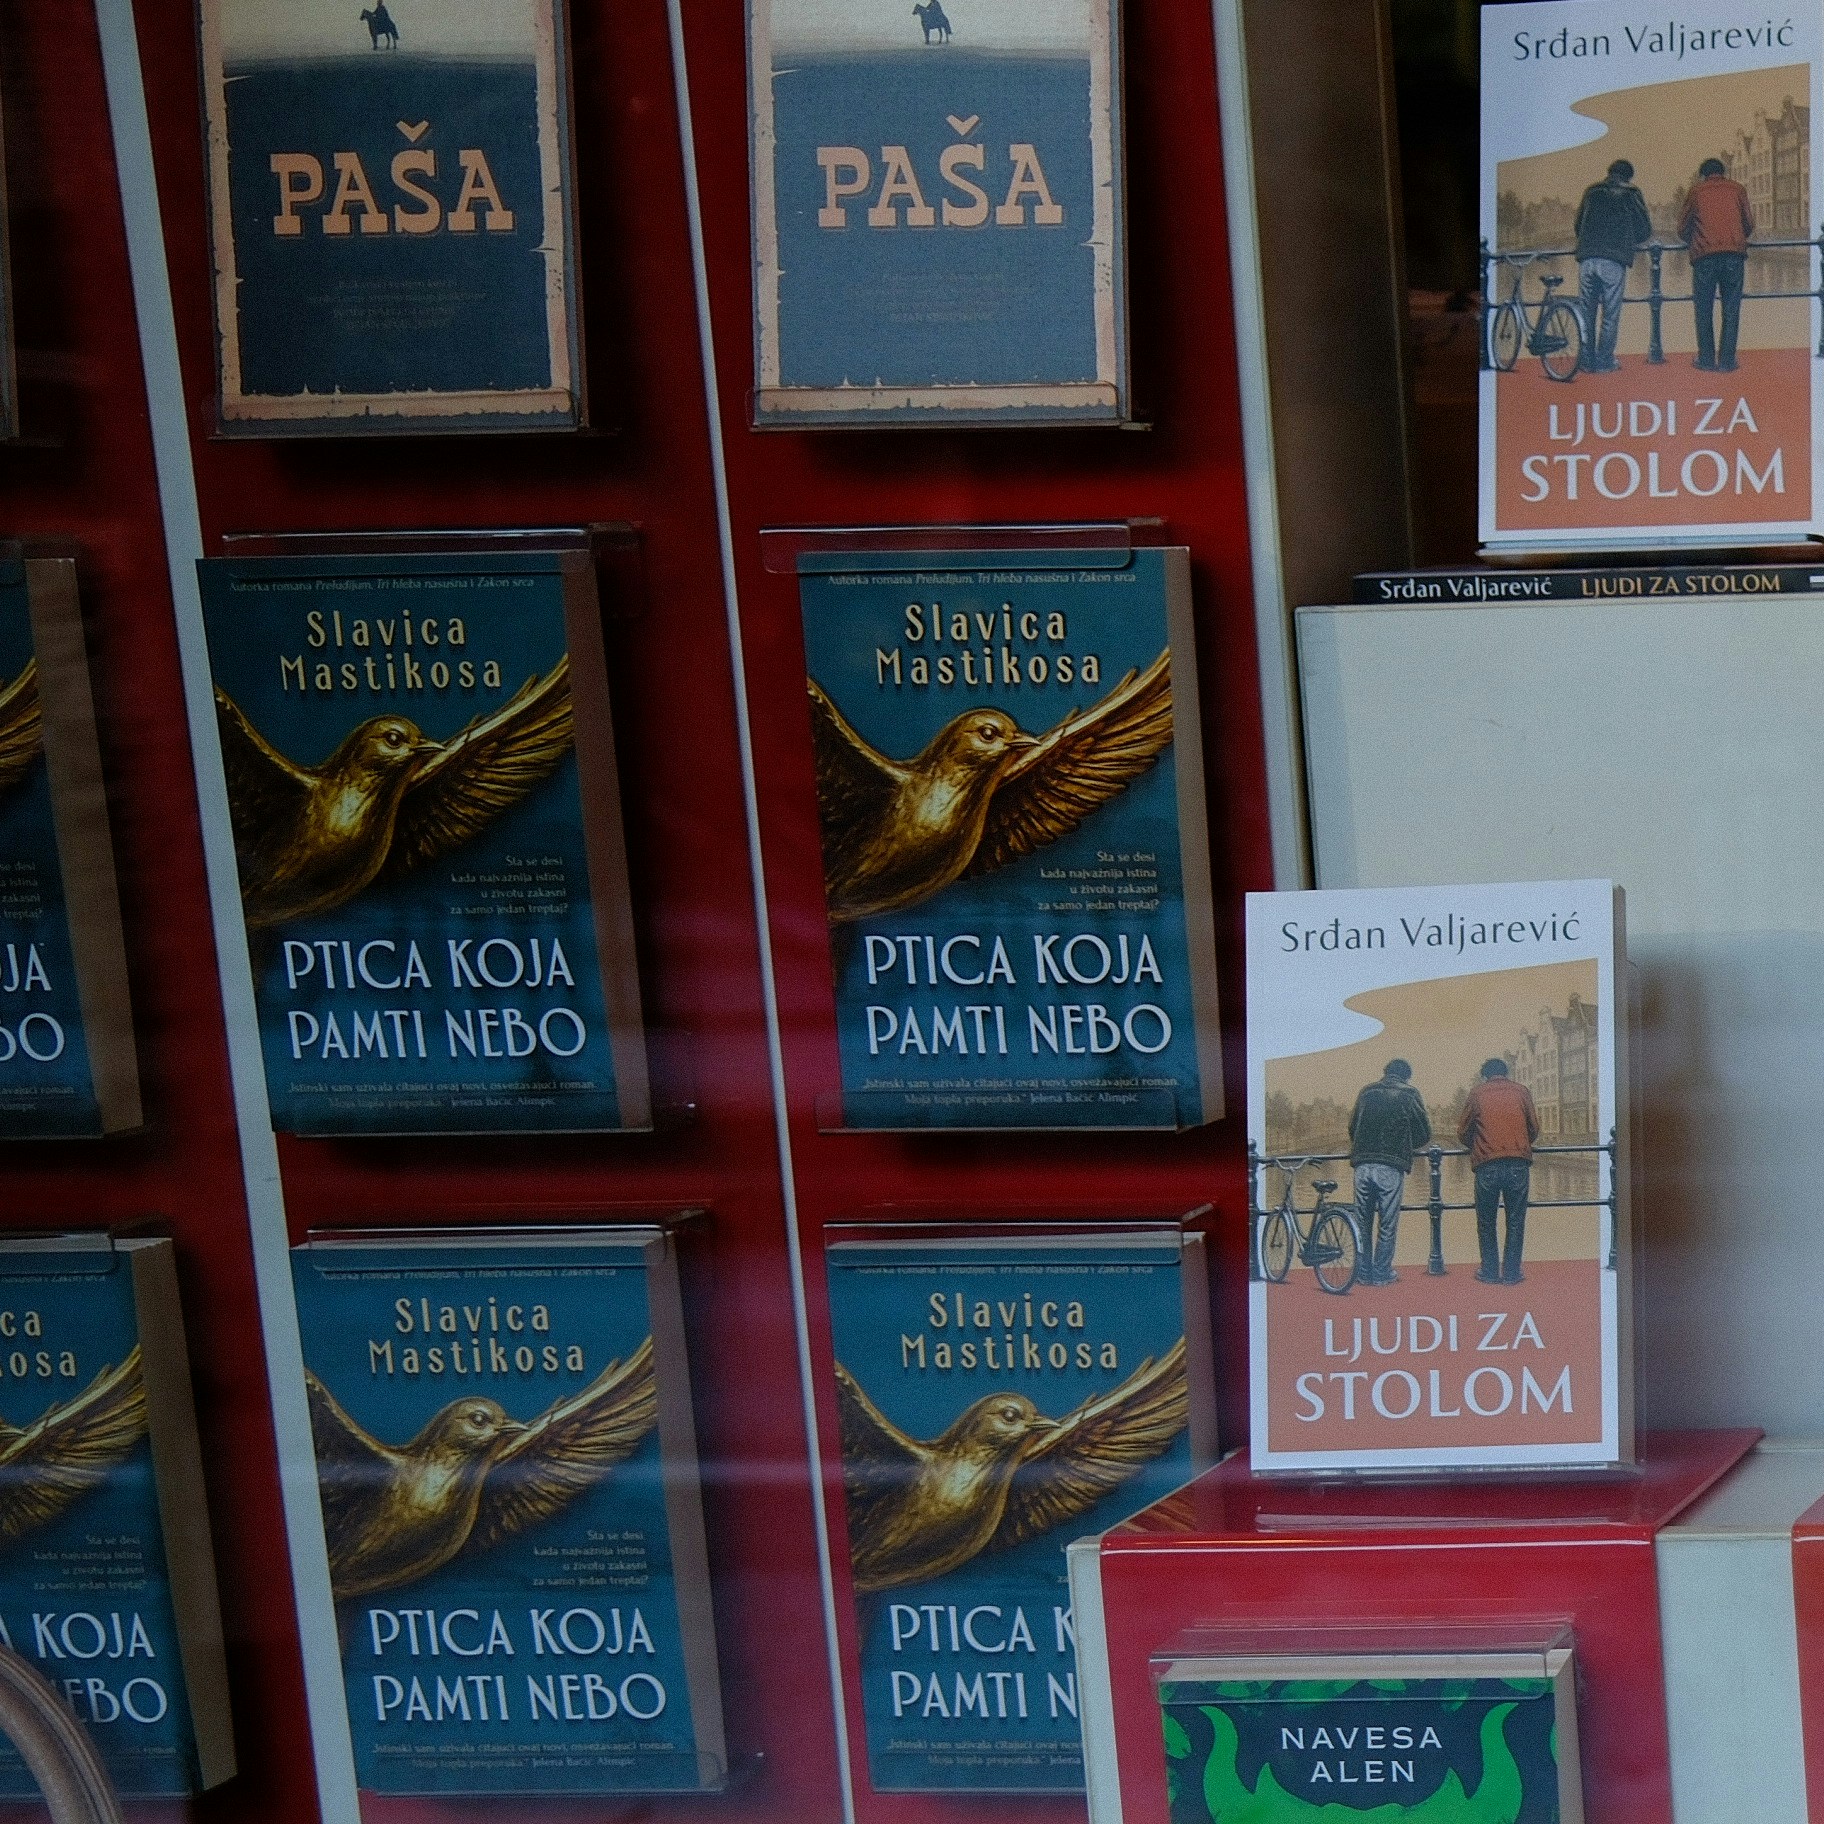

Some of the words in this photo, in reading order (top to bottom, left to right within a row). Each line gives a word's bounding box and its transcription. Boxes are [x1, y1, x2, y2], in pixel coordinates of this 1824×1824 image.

[1514, 28, 1610, 60] Srđan
[1624, 18, 1793, 58] Valjarević
[270, 120, 514, 236] PAŠA
[817, 114, 1062, 230] PAŠA
[1549, 400, 1676, 446] LJUDI
[1694, 398, 1757, 434] ZA
[1522, 448, 1784, 501] STOLOM
[1380, 578, 1442, 598] Srđan
[1448, 576, 1552, 600] Valjarević
[1582, 575, 1644, 597] LJUDI
[1650, 575, 1680, 595] ZA
[1686, 574, 1780, 593] STOLOM
[307, 610, 466, 648] Slavica
[281, 654, 502, 691] Mastikosa
[1282, 918, 1385, 952] Srđan
[1400, 912, 1580, 954] Valjarević
[284, 940, 432, 990] PTICA
[448, 938, 574, 988] KOJA
[288, 1010, 426, 1060] PAMTI
[444, 1007, 586, 1058] NEBO
[370, 1609, 514, 1656] PTICA
[531, 1608, 655, 1654] KOJA
[373, 1675, 510, 1722] PAMTI
[528, 1673, 666, 1719] NEBO
[1282, 1727, 1442, 1750] NAVESA
[1310, 1761, 1414, 1783] ALEN
